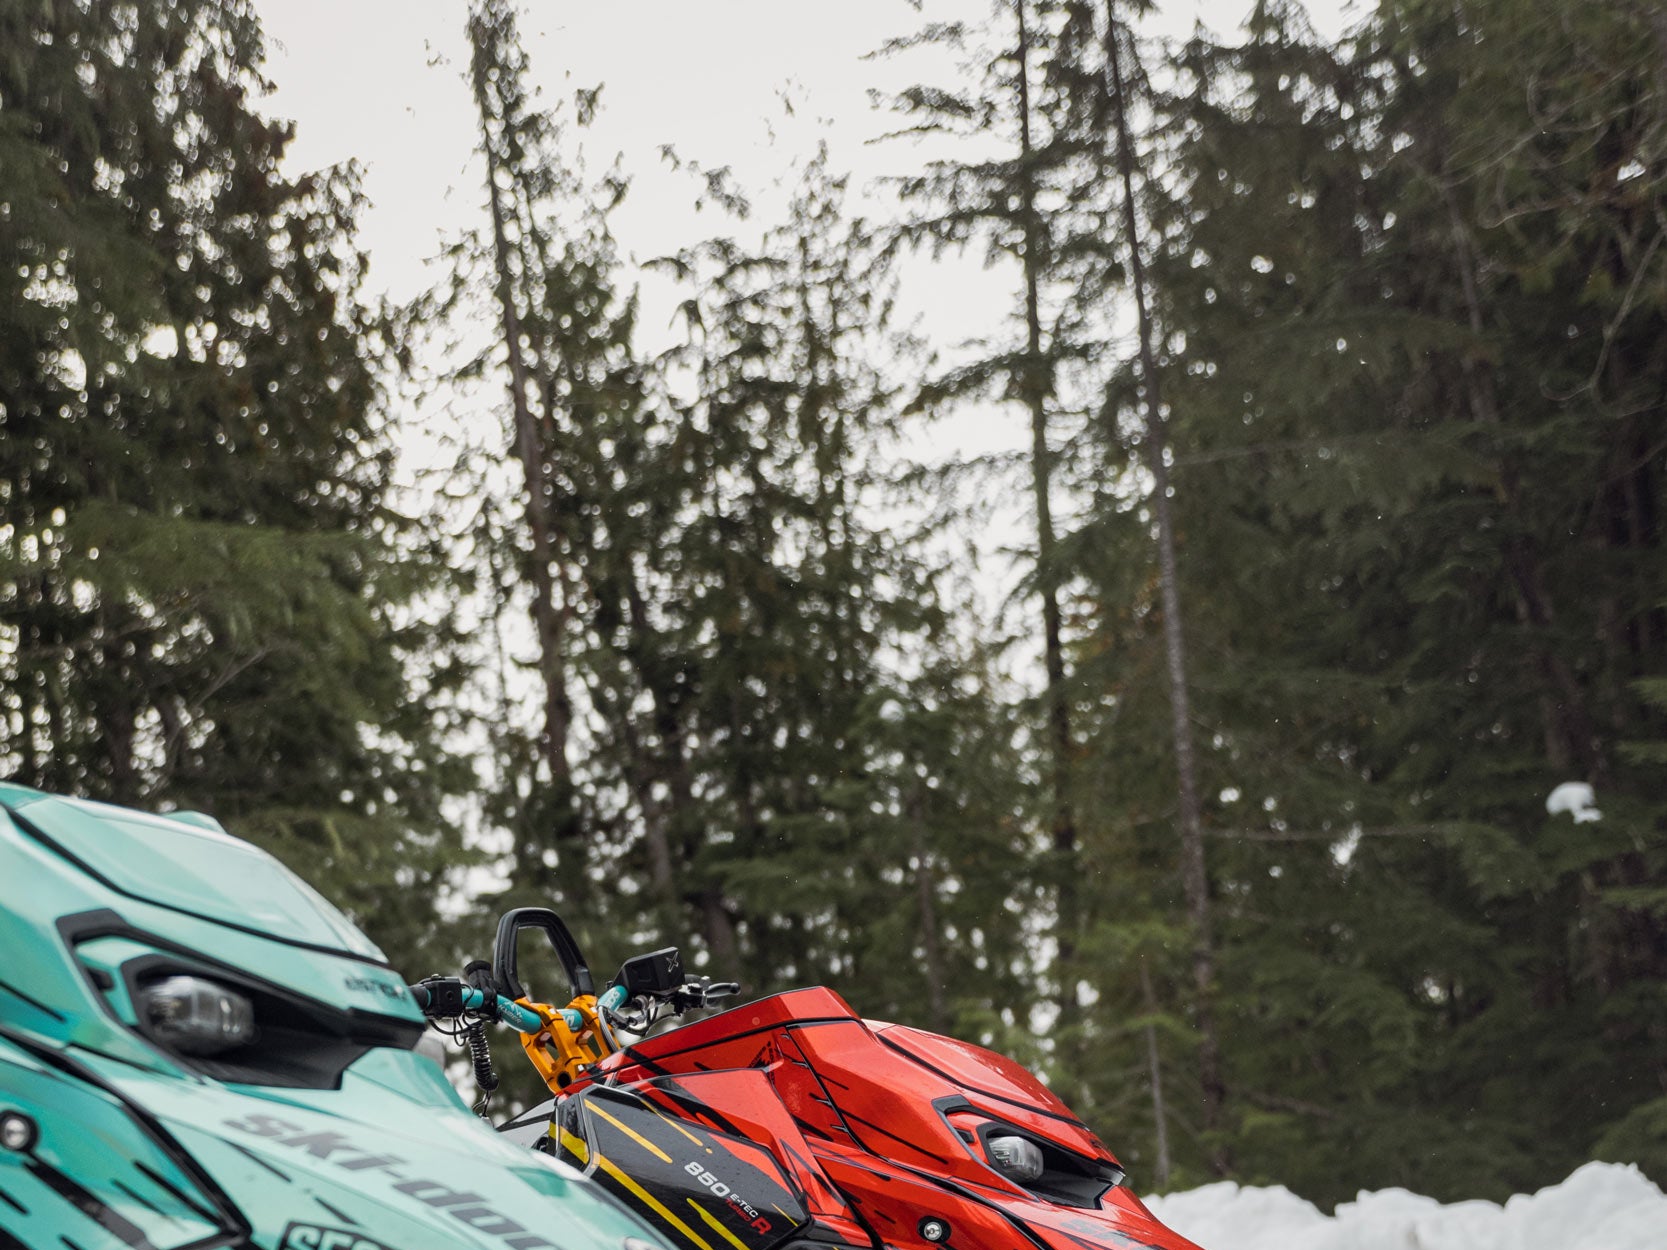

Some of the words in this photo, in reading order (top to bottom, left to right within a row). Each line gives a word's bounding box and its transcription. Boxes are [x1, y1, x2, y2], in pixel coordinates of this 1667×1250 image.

[684, 1161, 730, 1197] 850
[730, 1193, 758, 1218] E-TEC
[751, 1216, 772, 1235] R
